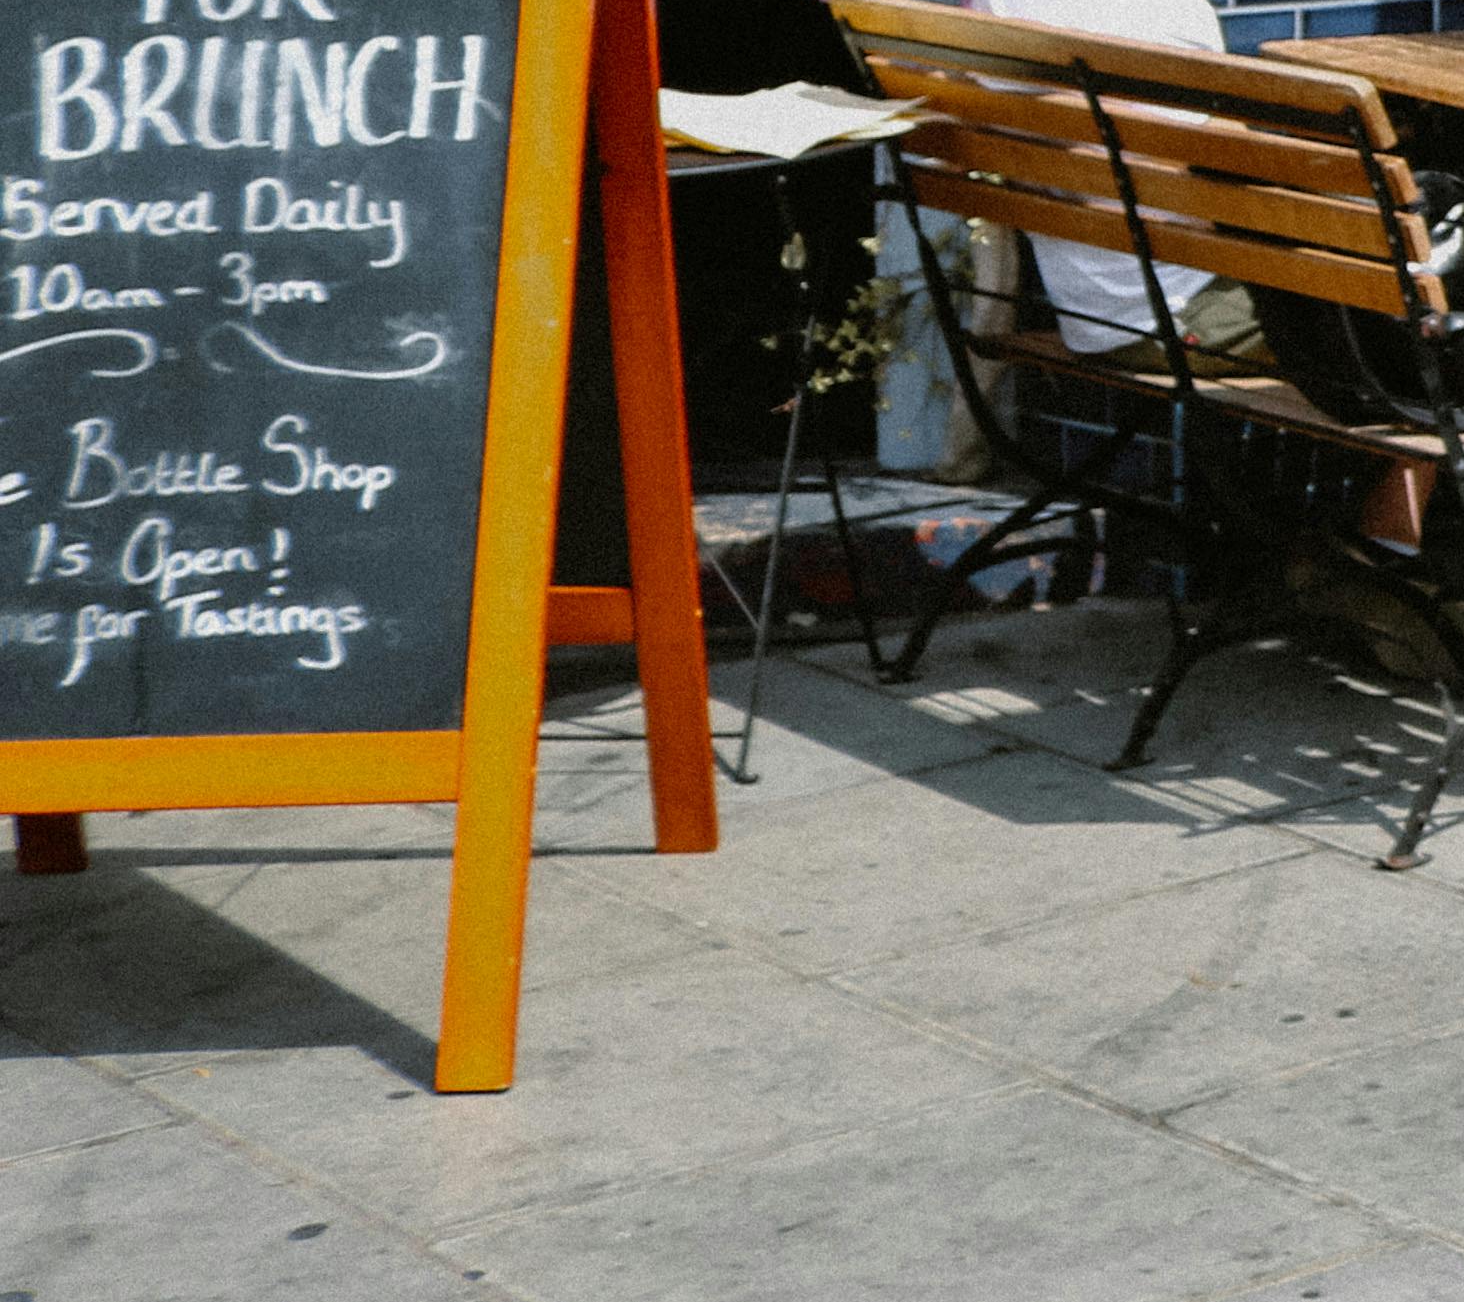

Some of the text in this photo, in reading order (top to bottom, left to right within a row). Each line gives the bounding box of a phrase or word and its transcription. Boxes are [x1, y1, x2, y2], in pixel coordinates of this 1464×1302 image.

[38, 34, 485, 162] BRUNCH
[3, 177, 406, 269] Served Daily
[9, 264, 163, 321] 10am
[220, 251, 329, 315] 3pm
[61, 417, 248, 508] Bottle
[261, 414, 394, 511] Shop
[61, 602, 147, 688] for
[163, 588, 368, 670] Tastings
